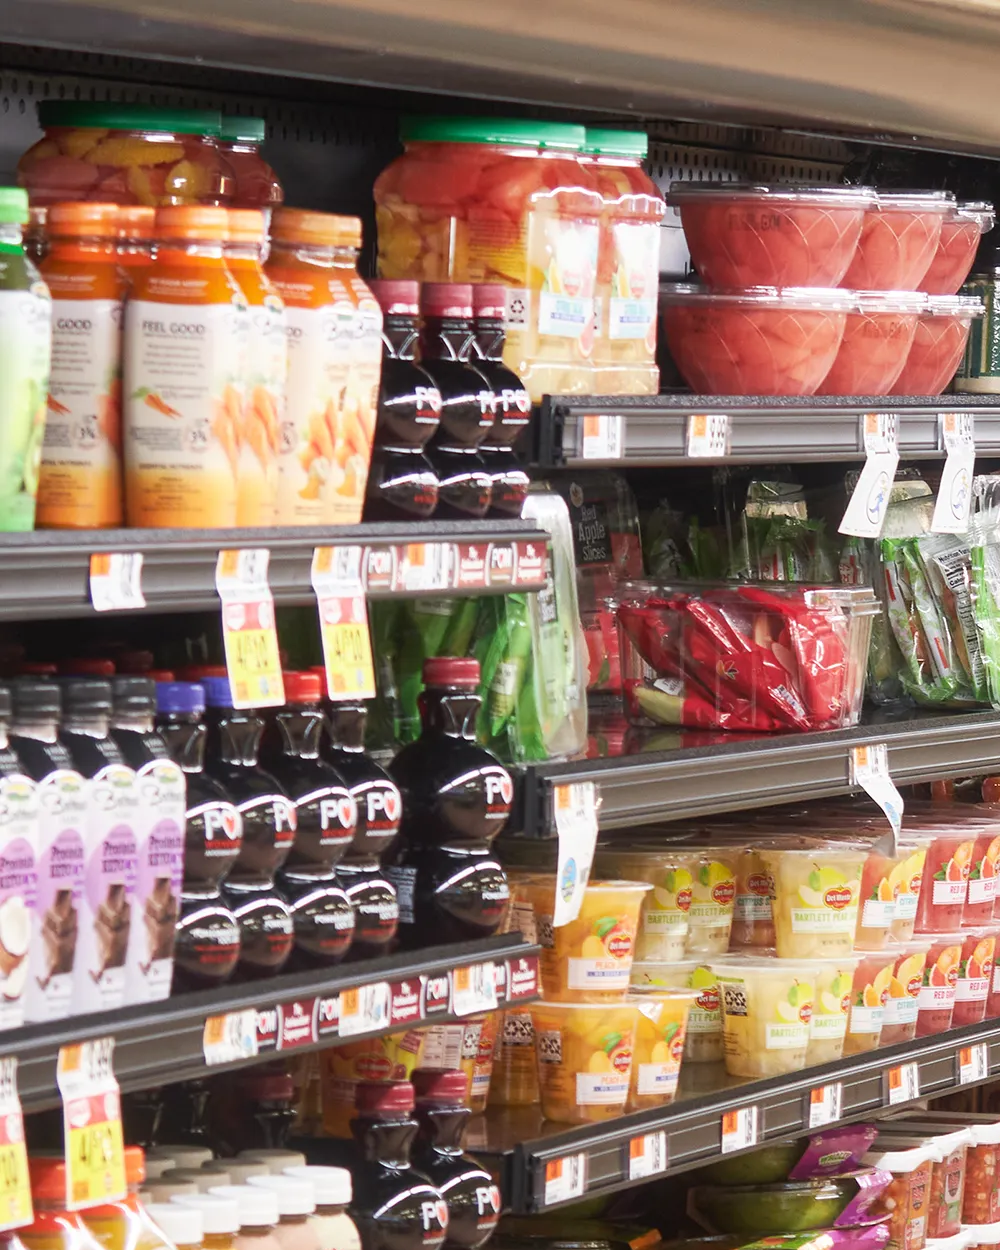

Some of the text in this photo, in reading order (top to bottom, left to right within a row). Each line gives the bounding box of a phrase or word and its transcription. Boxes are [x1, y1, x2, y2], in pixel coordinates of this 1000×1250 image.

[57, 318, 92, 331] GOOD
[142, 320, 205, 336] FEEL GOOD
[581, 505, 597, 521] Red
[578, 523, 606, 546] Apple
[583, 545, 606, 562] Slices
[795, 912, 831, 924] BARTLETT
